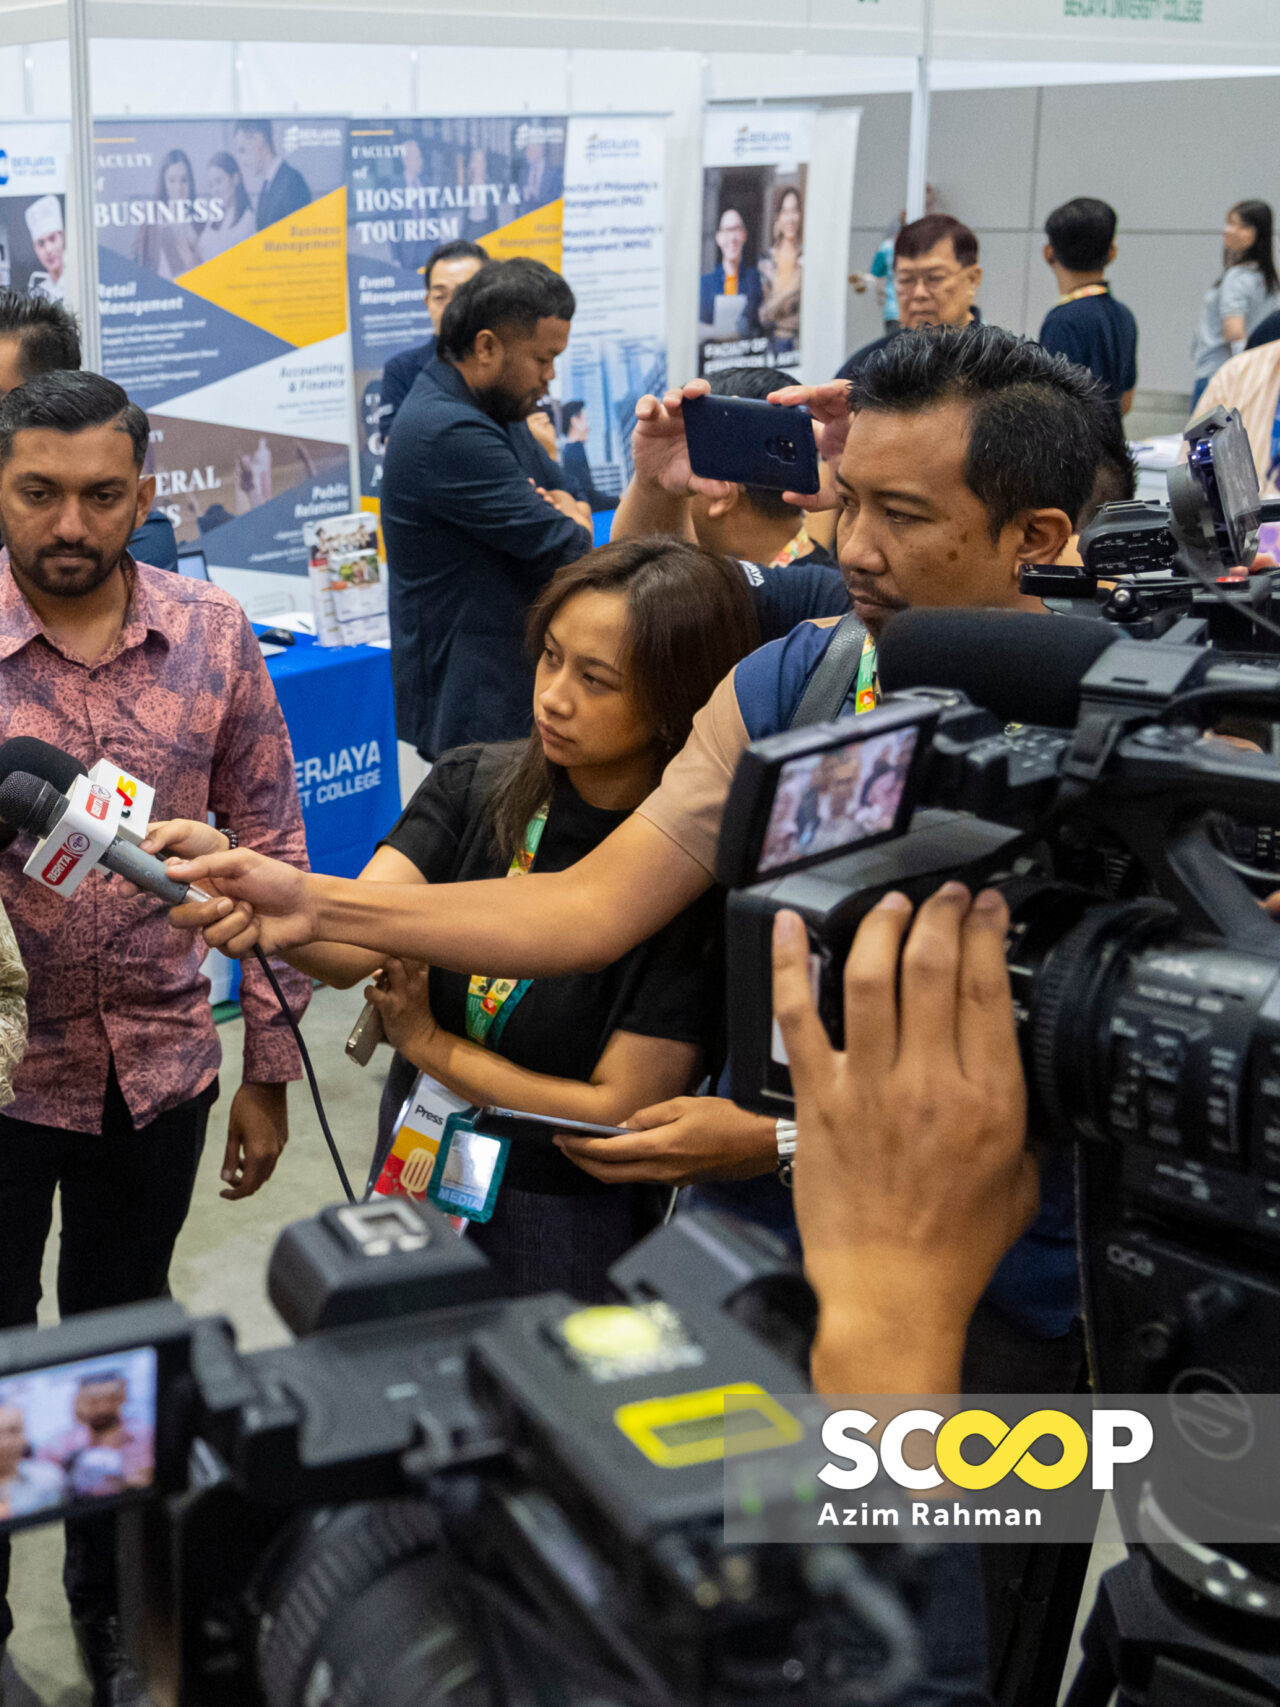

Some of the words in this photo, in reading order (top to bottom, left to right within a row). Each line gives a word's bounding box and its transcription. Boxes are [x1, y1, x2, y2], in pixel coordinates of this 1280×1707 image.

[96, 153, 152, 169] ACULTY
[351, 145, 408, 160] FACULTY
[355, 184, 506, 213] HOSPITALITY
[506, 183, 521, 205] &
[564, 184, 589, 193] octor
[94, 197, 225, 228] BUSINESS
[356, 217, 460, 244] TOURISM
[98, 280, 137, 299] Retail
[358, 275, 395, 290] Events
[98, 296, 184, 316] Management
[279, 363, 345, 378] Accounting
[288, 382, 296, 393] &
[300, 378, 345, 392] Finance
[155, 465, 223, 498] ERAL
[312, 485, 349, 500] Public
[294, 500, 349, 518] Relations
[294, 739, 381, 789] ERJAYA
[316, 768, 381, 804] COLLEGE
[46, 855, 73, 883] BERITA
[414, 1104, 445, 1126] Press
[437, 1187, 484, 1212] MEDIA
